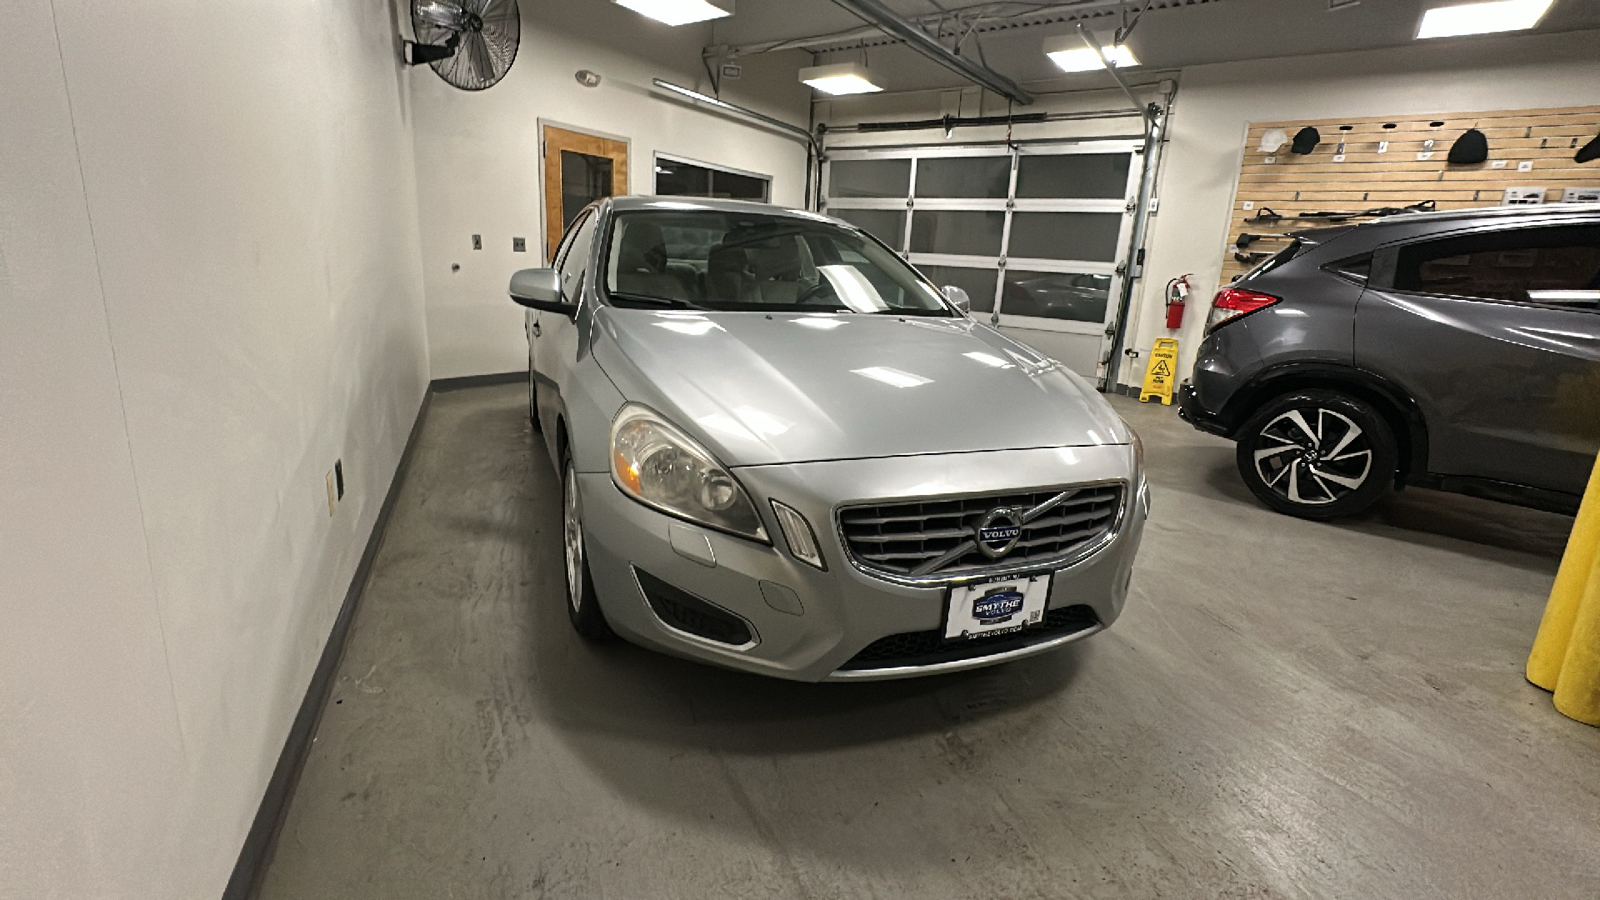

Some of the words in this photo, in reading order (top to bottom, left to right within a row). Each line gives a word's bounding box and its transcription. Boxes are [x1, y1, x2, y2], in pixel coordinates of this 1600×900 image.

[983, 530, 1019, 539] VOLVO
[975, 600, 1020, 612] SMYTHE
[985, 607, 1012, 616] VOLVO
